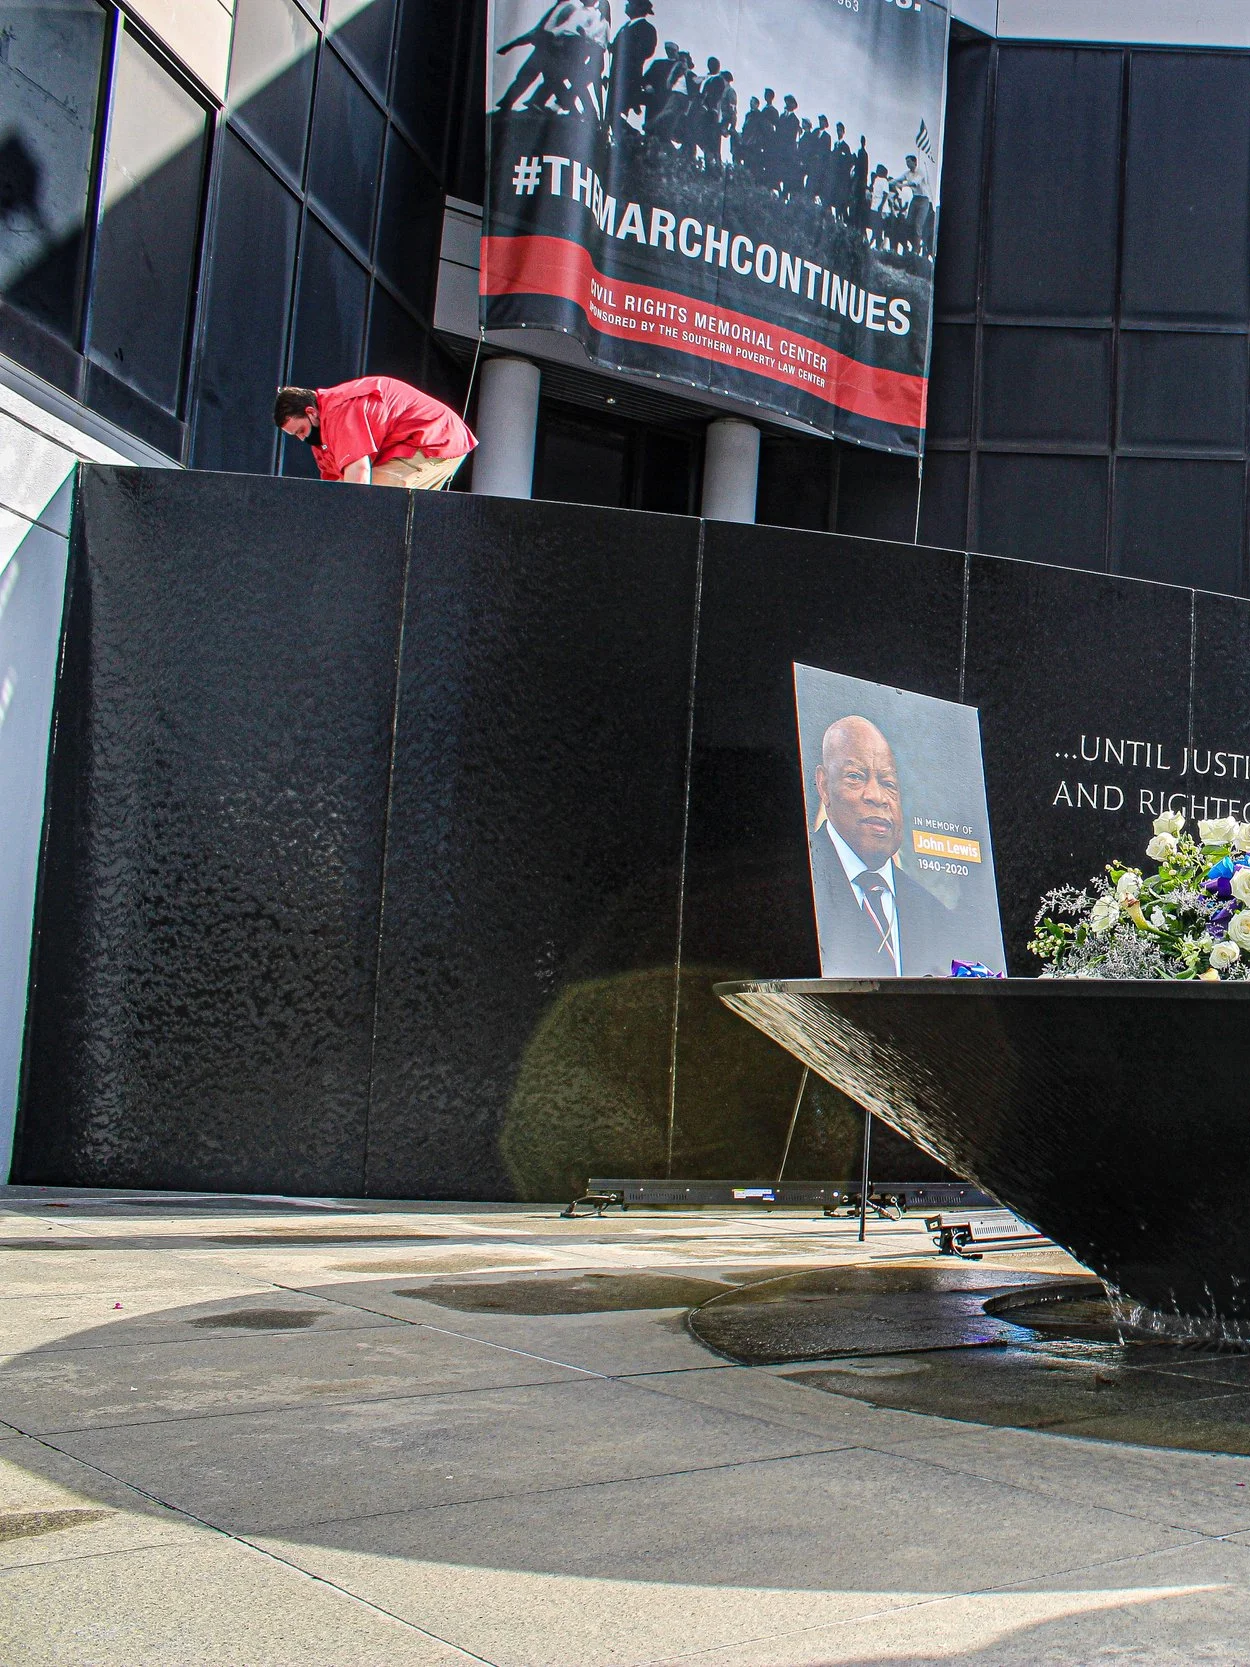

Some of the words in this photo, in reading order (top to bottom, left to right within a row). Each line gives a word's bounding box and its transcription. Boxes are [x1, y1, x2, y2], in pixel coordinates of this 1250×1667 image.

[590, 277, 617, 308] CIVIL
[624, 294, 688, 324] RIGHTS
[694, 311, 774, 351] MEMORIAL
[779, 340, 828, 373] CENTER
[589, 300, 637, 329] SPONSORED
[641, 321, 656, 333] BY
[658, 324, 679, 339] THE
[682, 330, 732, 355] SOUTHERN
[735, 347, 777, 368] POVERTY
[777, 360, 796, 375] LAW
[798, 368, 826, 389] CENTER
[1053, 781, 1124, 811] AND
[914, 817, 923, 826] IN
[925, 819, 960, 833] MEMORY
[962, 826, 973, 835] OF
[917, 835, 944, 852] John
[948, 841, 978, 857] Lewis
